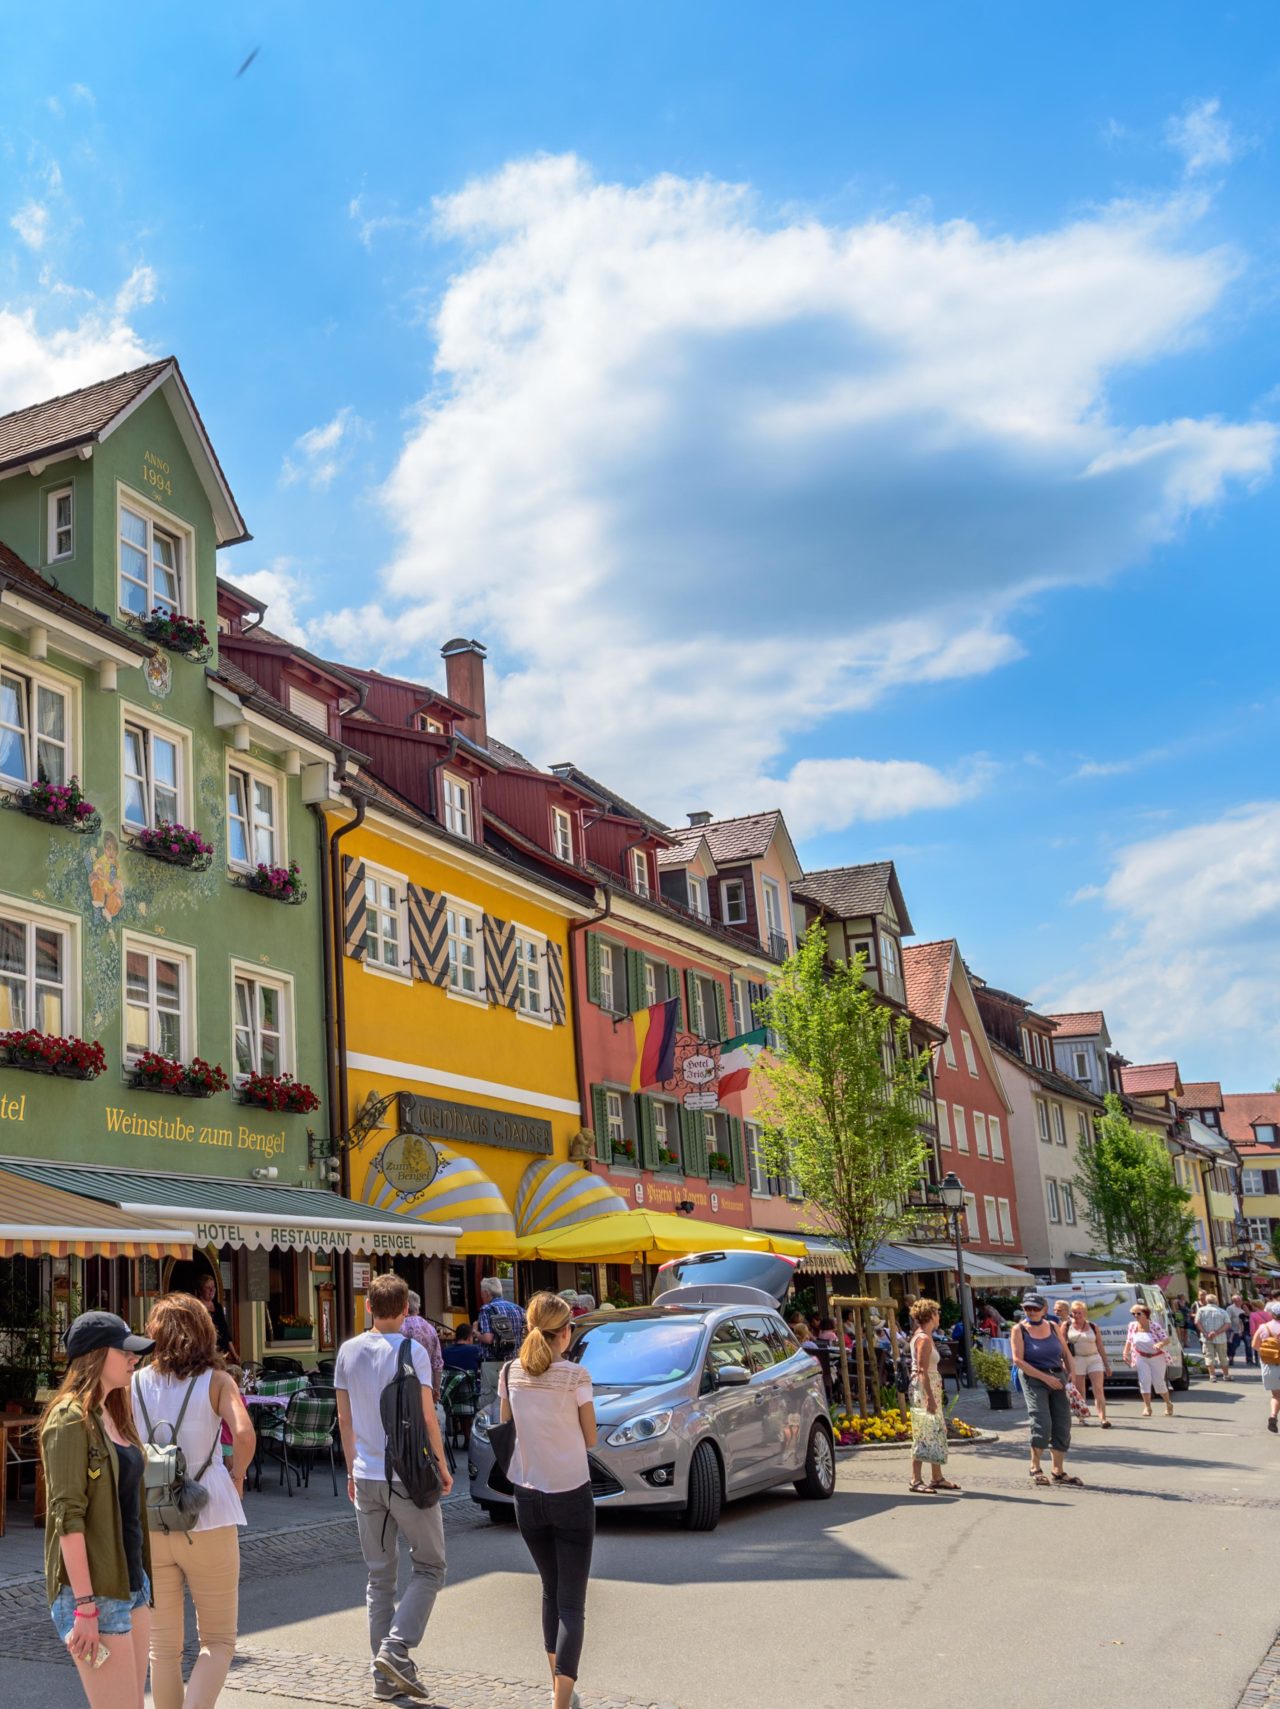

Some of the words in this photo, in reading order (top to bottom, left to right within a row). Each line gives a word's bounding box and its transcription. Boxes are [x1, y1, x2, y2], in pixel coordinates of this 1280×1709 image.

[144, 450, 170, 474] ANNO
[143, 465, 173, 496] 1994
[687, 1060, 709, 1070] Hotel
[105, 1107, 195, 1142] Weinstube
[199, 1126, 233, 1147] zum
[237, 1126, 286, 1158] Bengel
[398, 1171, 430, 1182] Bengel
[197, 1223, 245, 1241] HOTEL
[271, 1228, 353, 1246] RESTAURANT
[373, 1234, 416, 1249] BENGEL
